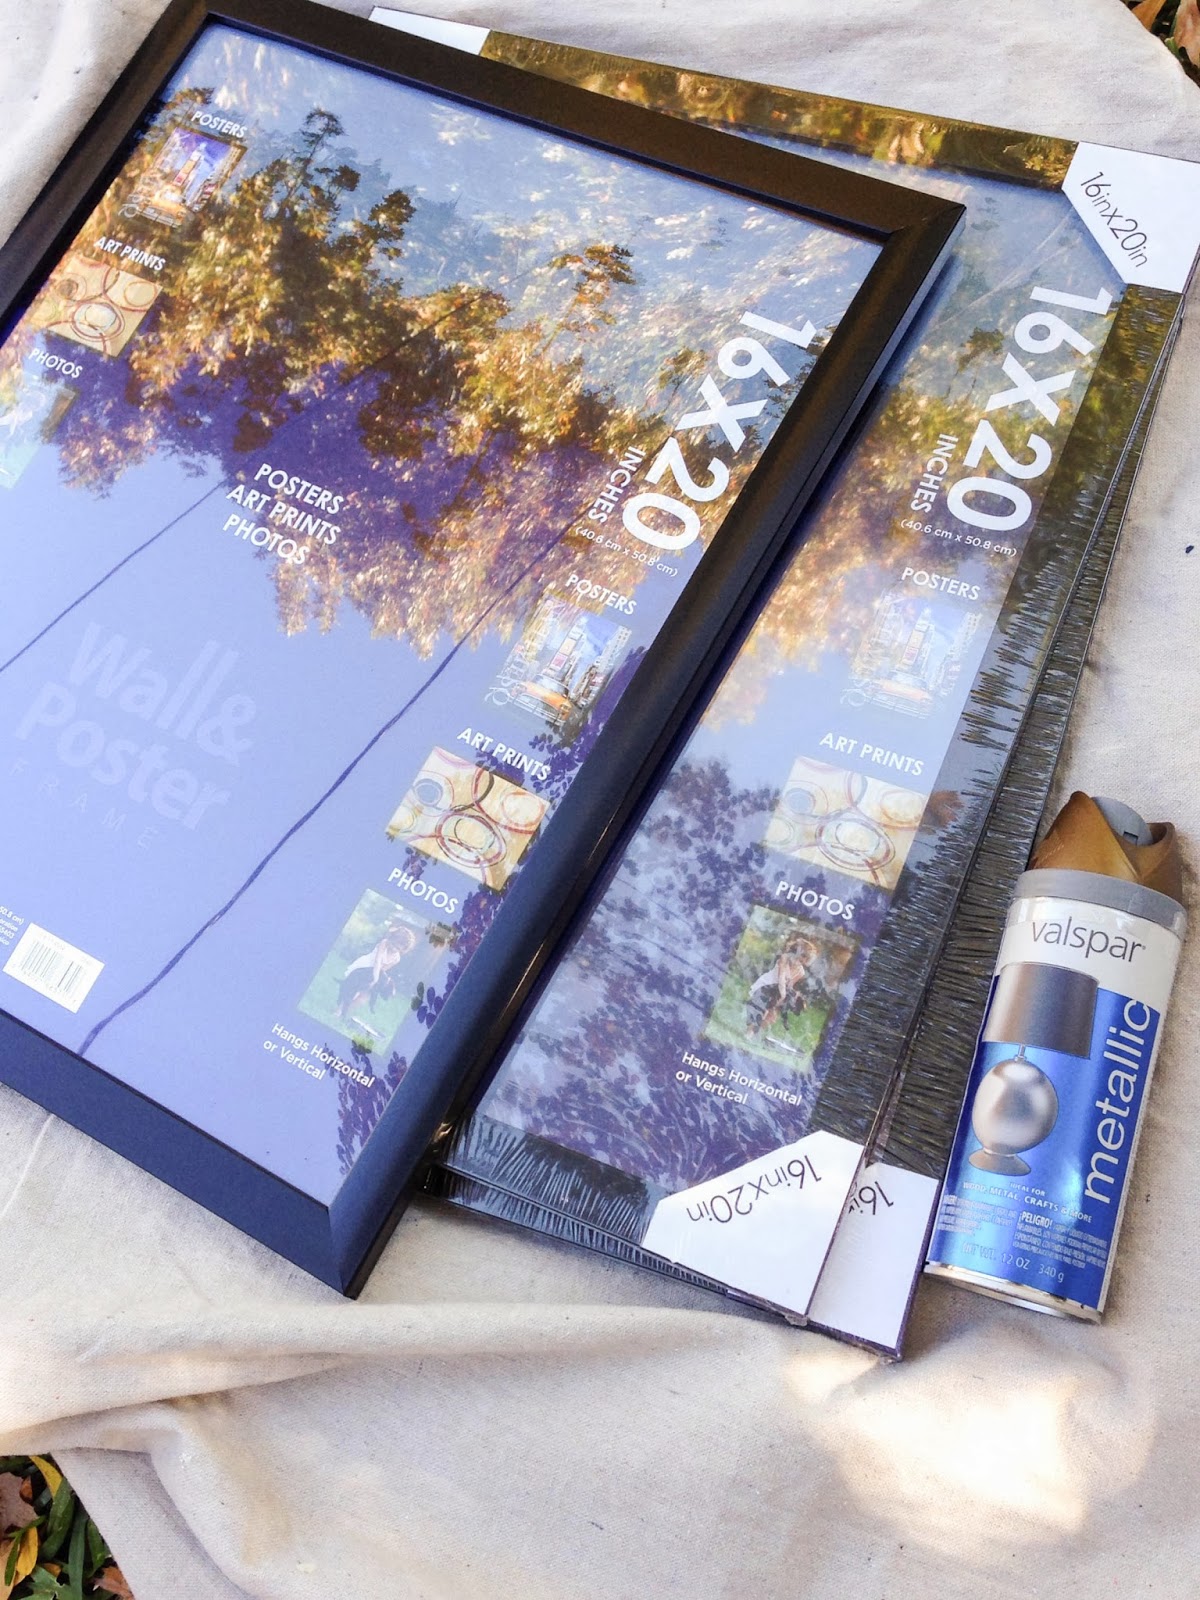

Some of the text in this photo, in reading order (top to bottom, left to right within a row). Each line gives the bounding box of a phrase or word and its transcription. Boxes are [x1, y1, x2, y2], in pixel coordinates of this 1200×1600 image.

[191, 111, 248, 138] POSTERS
[1080, 171, 1149, 268] 16inx20in
[94, 236, 166, 271] ART PRINTS
[29, 348, 83, 379] PHOTOS
[254, 463, 344, 515] POSTERS
[588, 446, 646, 523] INCHES
[911, 433, 958, 514] INCHES
[226, 484, 341, 546] ART PRINTS
[900, 517, 931, 534] (40.6
[933, 527, 952, 540] cm
[965, 533, 991, 550] 50.8
[992, 545, 1017, 558] cm)
[223, 513, 310, 565] PHOTOS
[574, 524, 604, 545] (40.6
[604, 538, 622, 553] cm
[656, 561, 679, 578] cm)
[565, 574, 637, 615] POSTERS
[901, 566, 981, 601] POSTERS
[13, 681, 232, 830] Poster
[457, 727, 551, 781] ART PRINTS
[819, 732, 924, 776] ART PRINTS
[387, 867, 459, 914] PHOTOS
[775, 880, 855, 921] PHOTOS
[1032, 916, 1142, 963] valspar
[263, 1040, 326, 1080] or Vertical
[271, 1023, 375, 1088] Hangs Horizontal
[682, 1051, 803, 1107] Hangs Horizontal
[675, 1069, 748, 1107] or Vertical
[1084, 998, 1152, 1204] metallic
[1024, 1195, 1059, 1212] CRAFTS
[1070, 1209, 1092, 1223] MORE
[1031, 1187, 1046, 1198] FOR
[1015, 1256, 1031, 1270] OZ
[1038, 1263, 1057, 1278] 340
[1057, 1272, 1065, 1283] g
